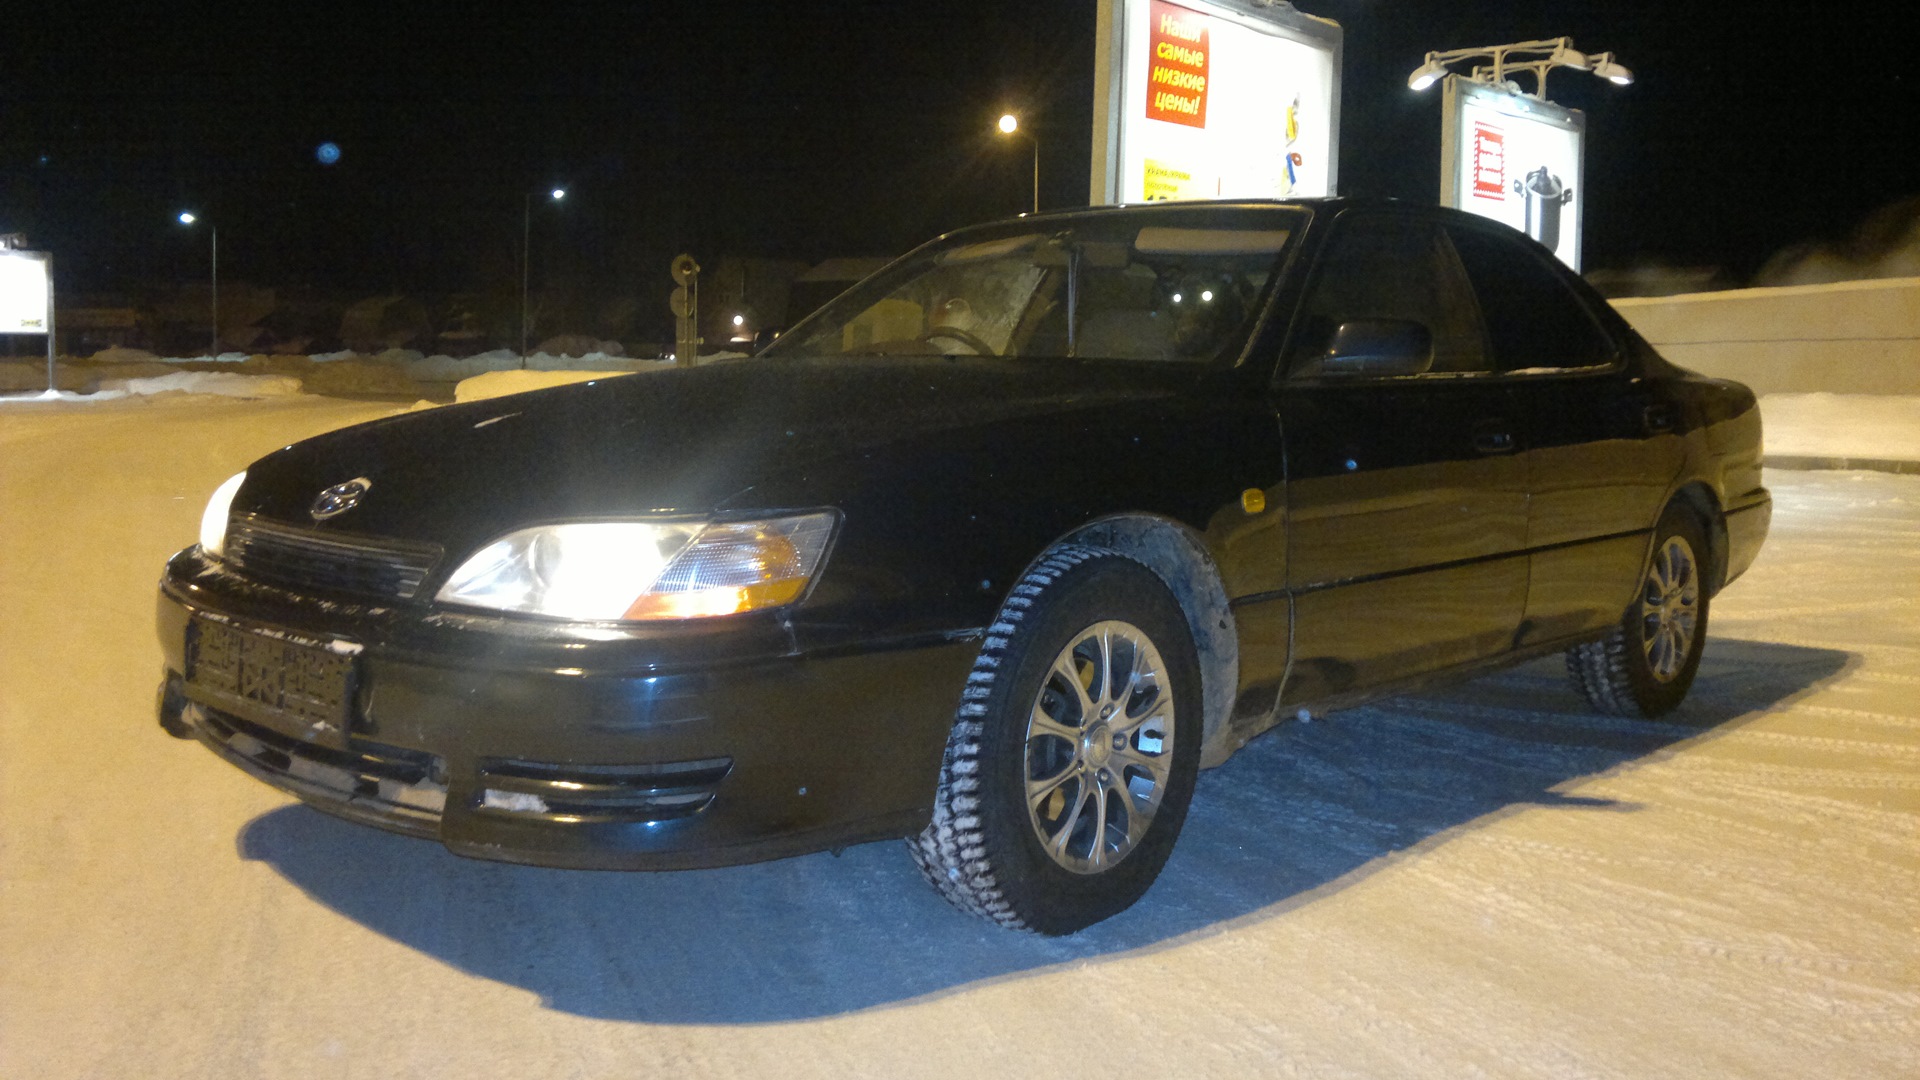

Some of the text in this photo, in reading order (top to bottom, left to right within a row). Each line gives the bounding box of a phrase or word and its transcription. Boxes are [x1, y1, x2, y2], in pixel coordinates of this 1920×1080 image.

[1160, 13, 1200, 43] Наши
[1156, 41, 1204, 68] самые
[1152, 65, 1206, 92] низкие
[1154, 91, 1201, 115] цены!
